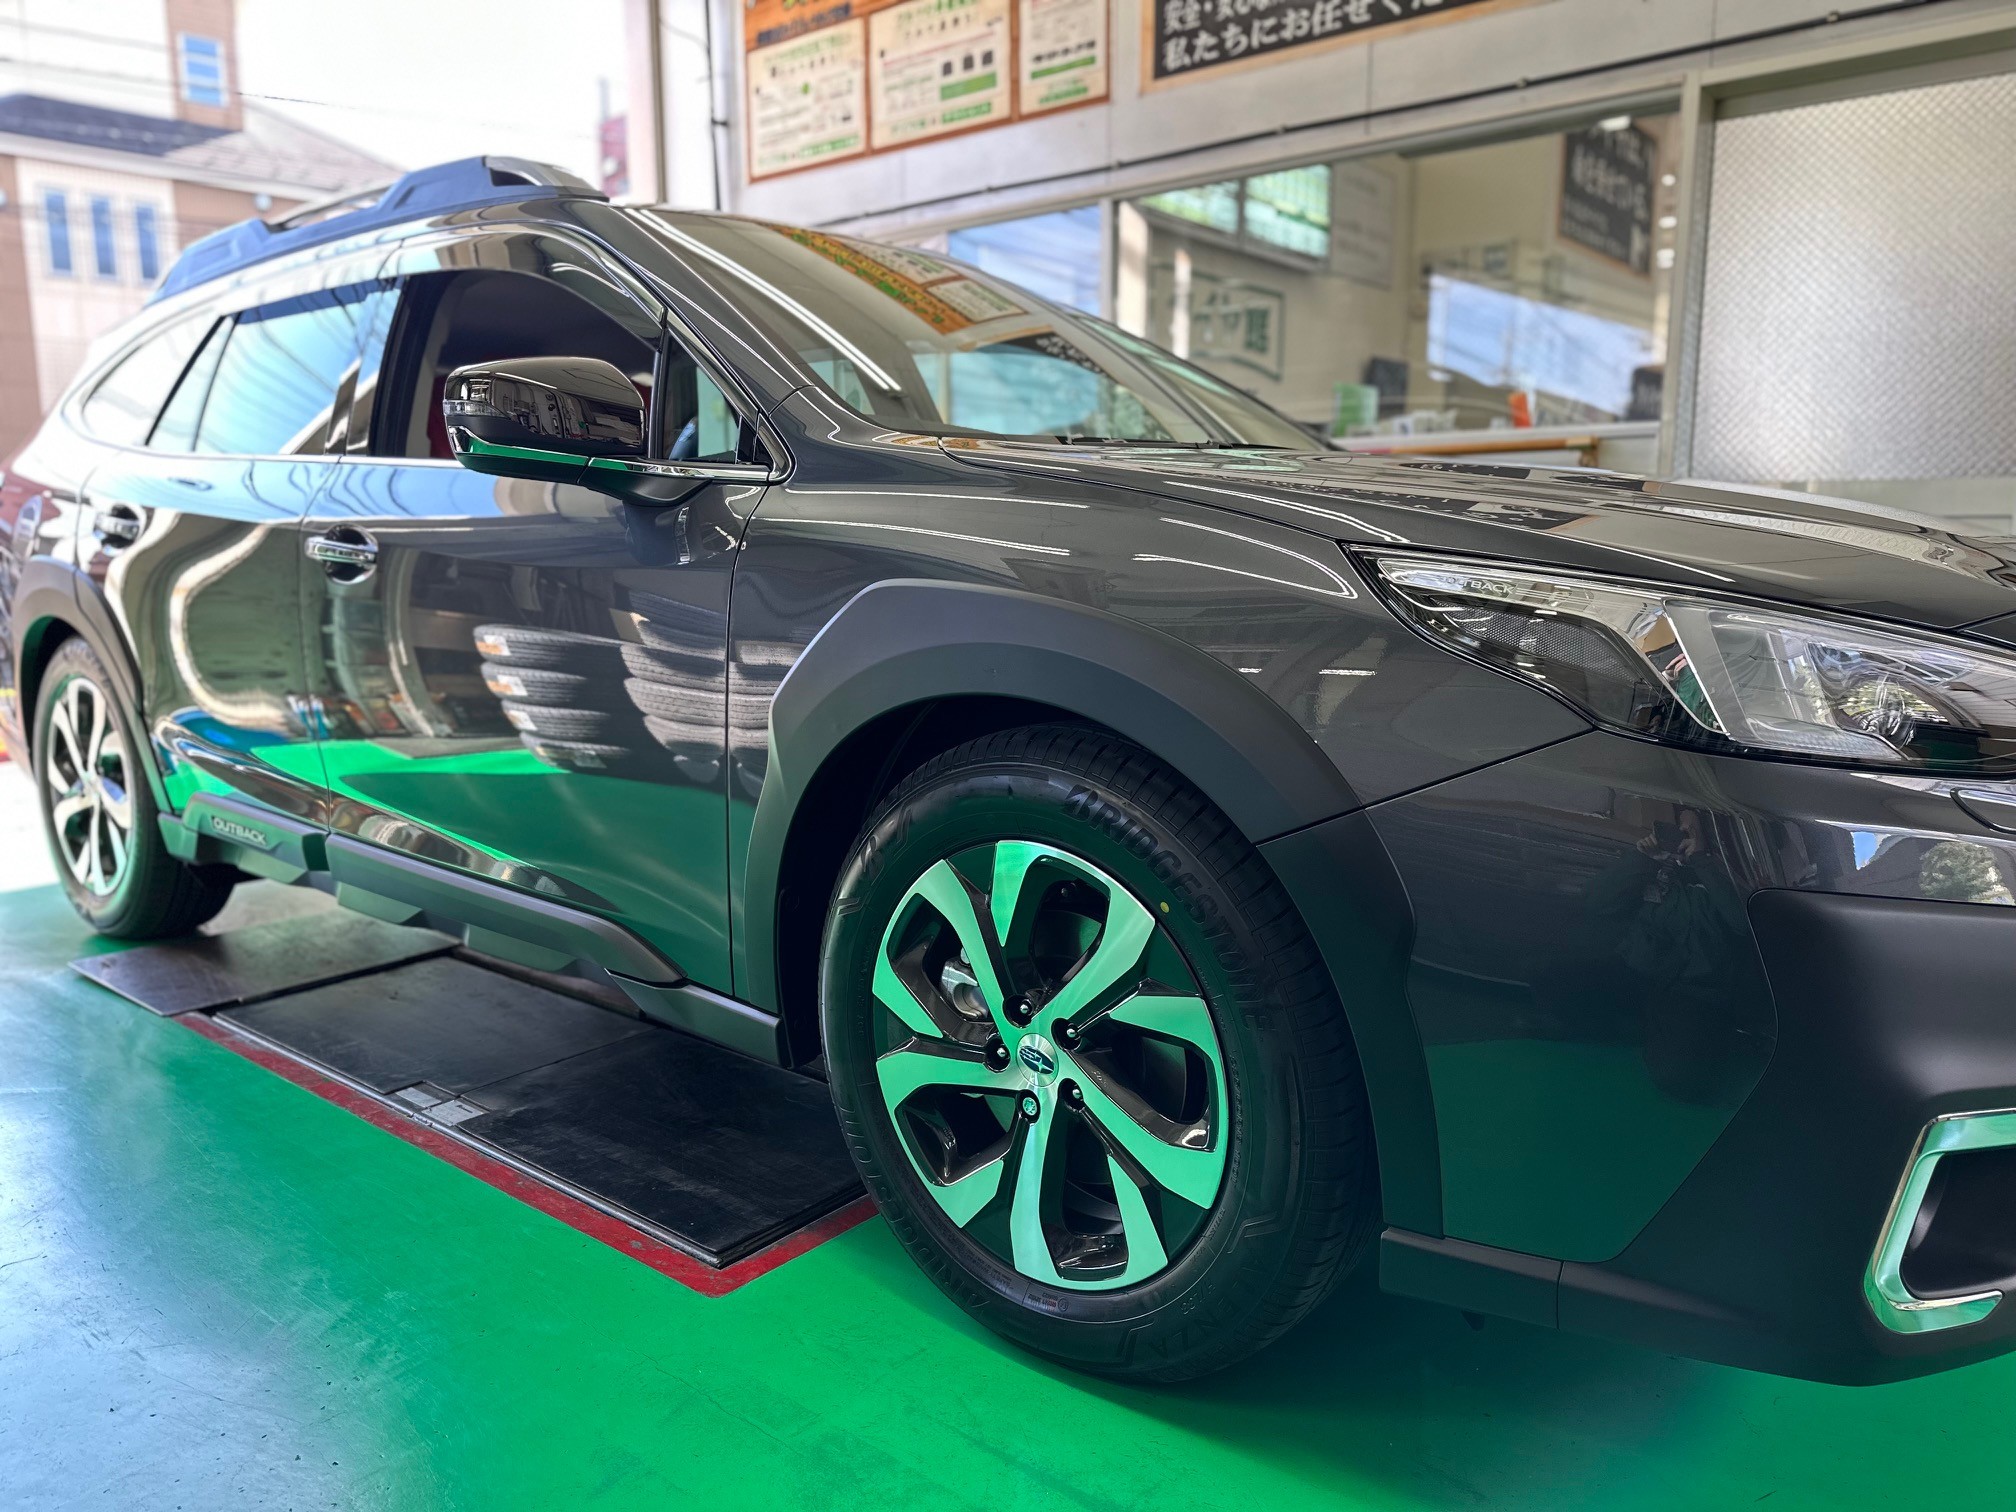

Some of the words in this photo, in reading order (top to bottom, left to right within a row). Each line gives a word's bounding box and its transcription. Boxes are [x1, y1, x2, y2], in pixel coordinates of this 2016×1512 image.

[1163, 0, 1444, 71] 私たちにお任せく
[1440, 575, 1515, 594] OUTBACK
[213, 817, 266, 845] OUTBACK
[1061, 783, 1276, 1032] BRIDGESTONE
